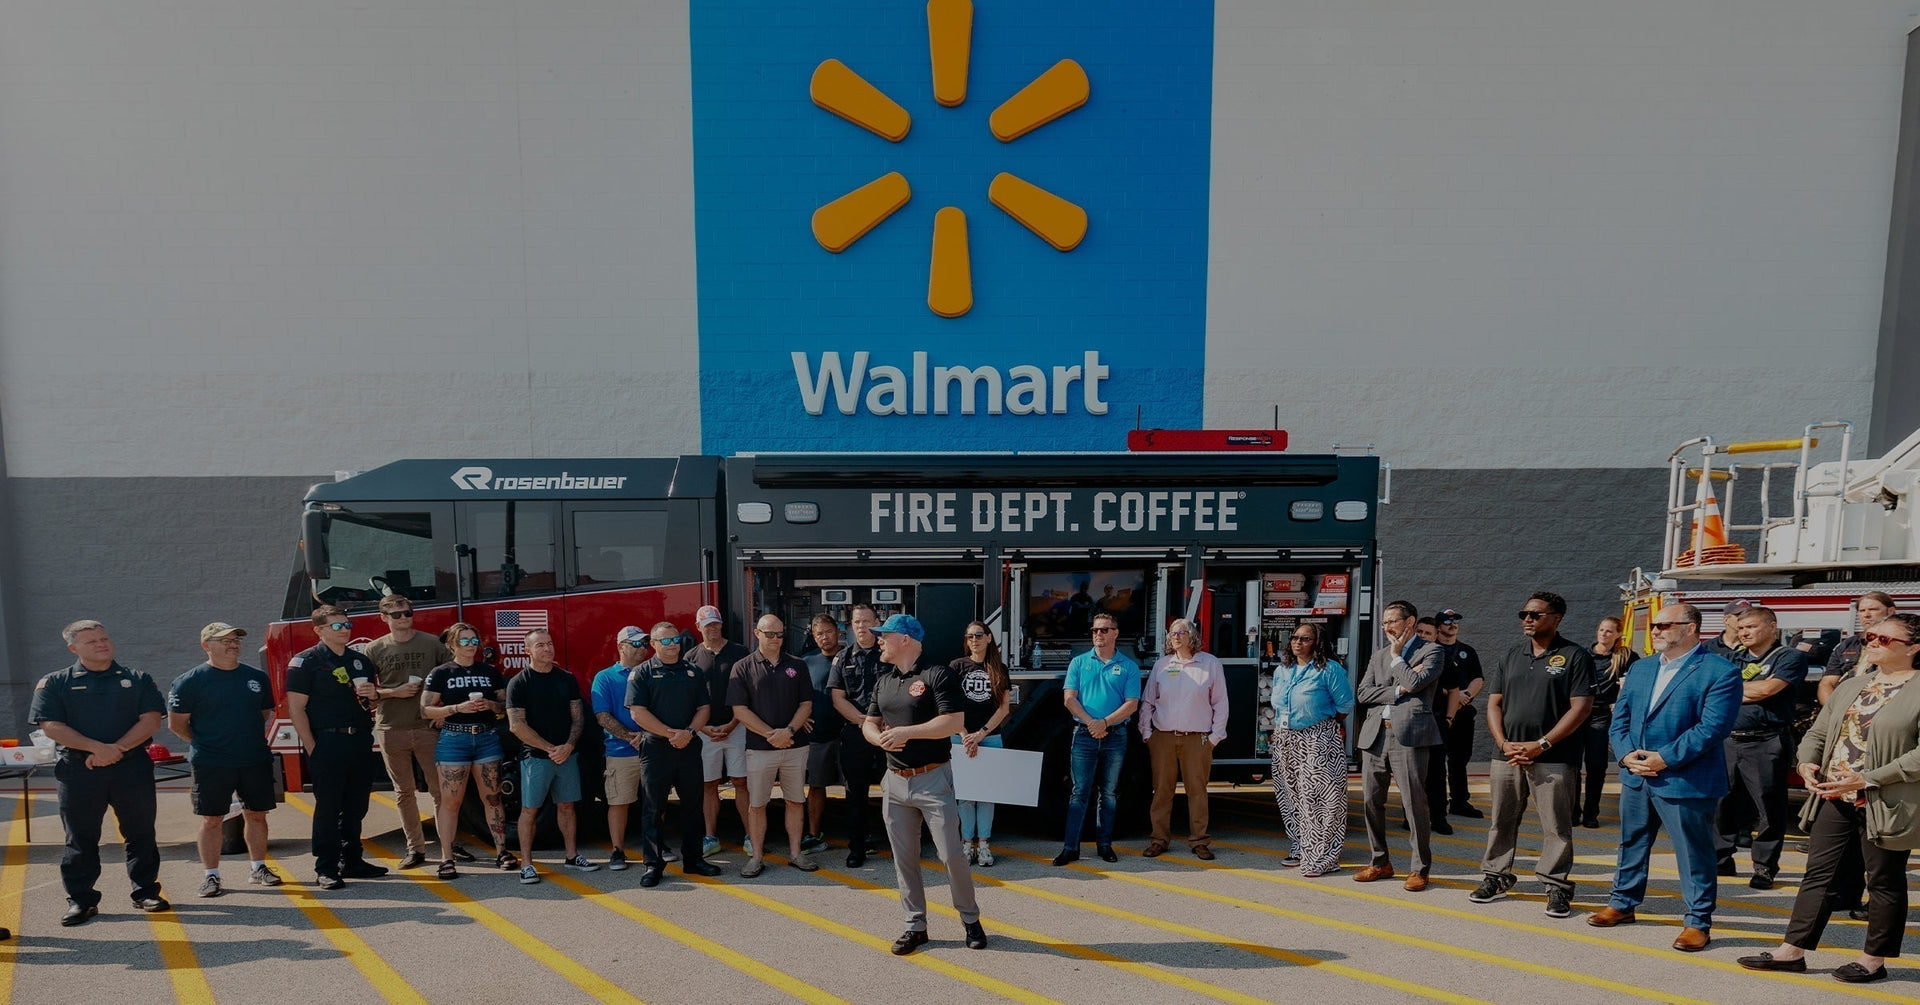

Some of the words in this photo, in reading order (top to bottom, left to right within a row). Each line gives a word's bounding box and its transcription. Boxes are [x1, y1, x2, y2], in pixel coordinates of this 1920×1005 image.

[791, 350, 1109, 416] Walmart
[494, 471, 627, 490] rosenbauer
[870, 492, 957, 532] FIRE
[971, 492, 1079, 532] DEPT.
[1093, 491, 1239, 531] COFFEE
[499, 643, 525, 655] VETE
[404, 652, 425, 661] DEPT
[503, 656, 530, 669] OWN
[388, 661, 422, 671] COFFEE
[447, 675, 492, 689] COFFEE
[966, 679, 992, 692] FDC
